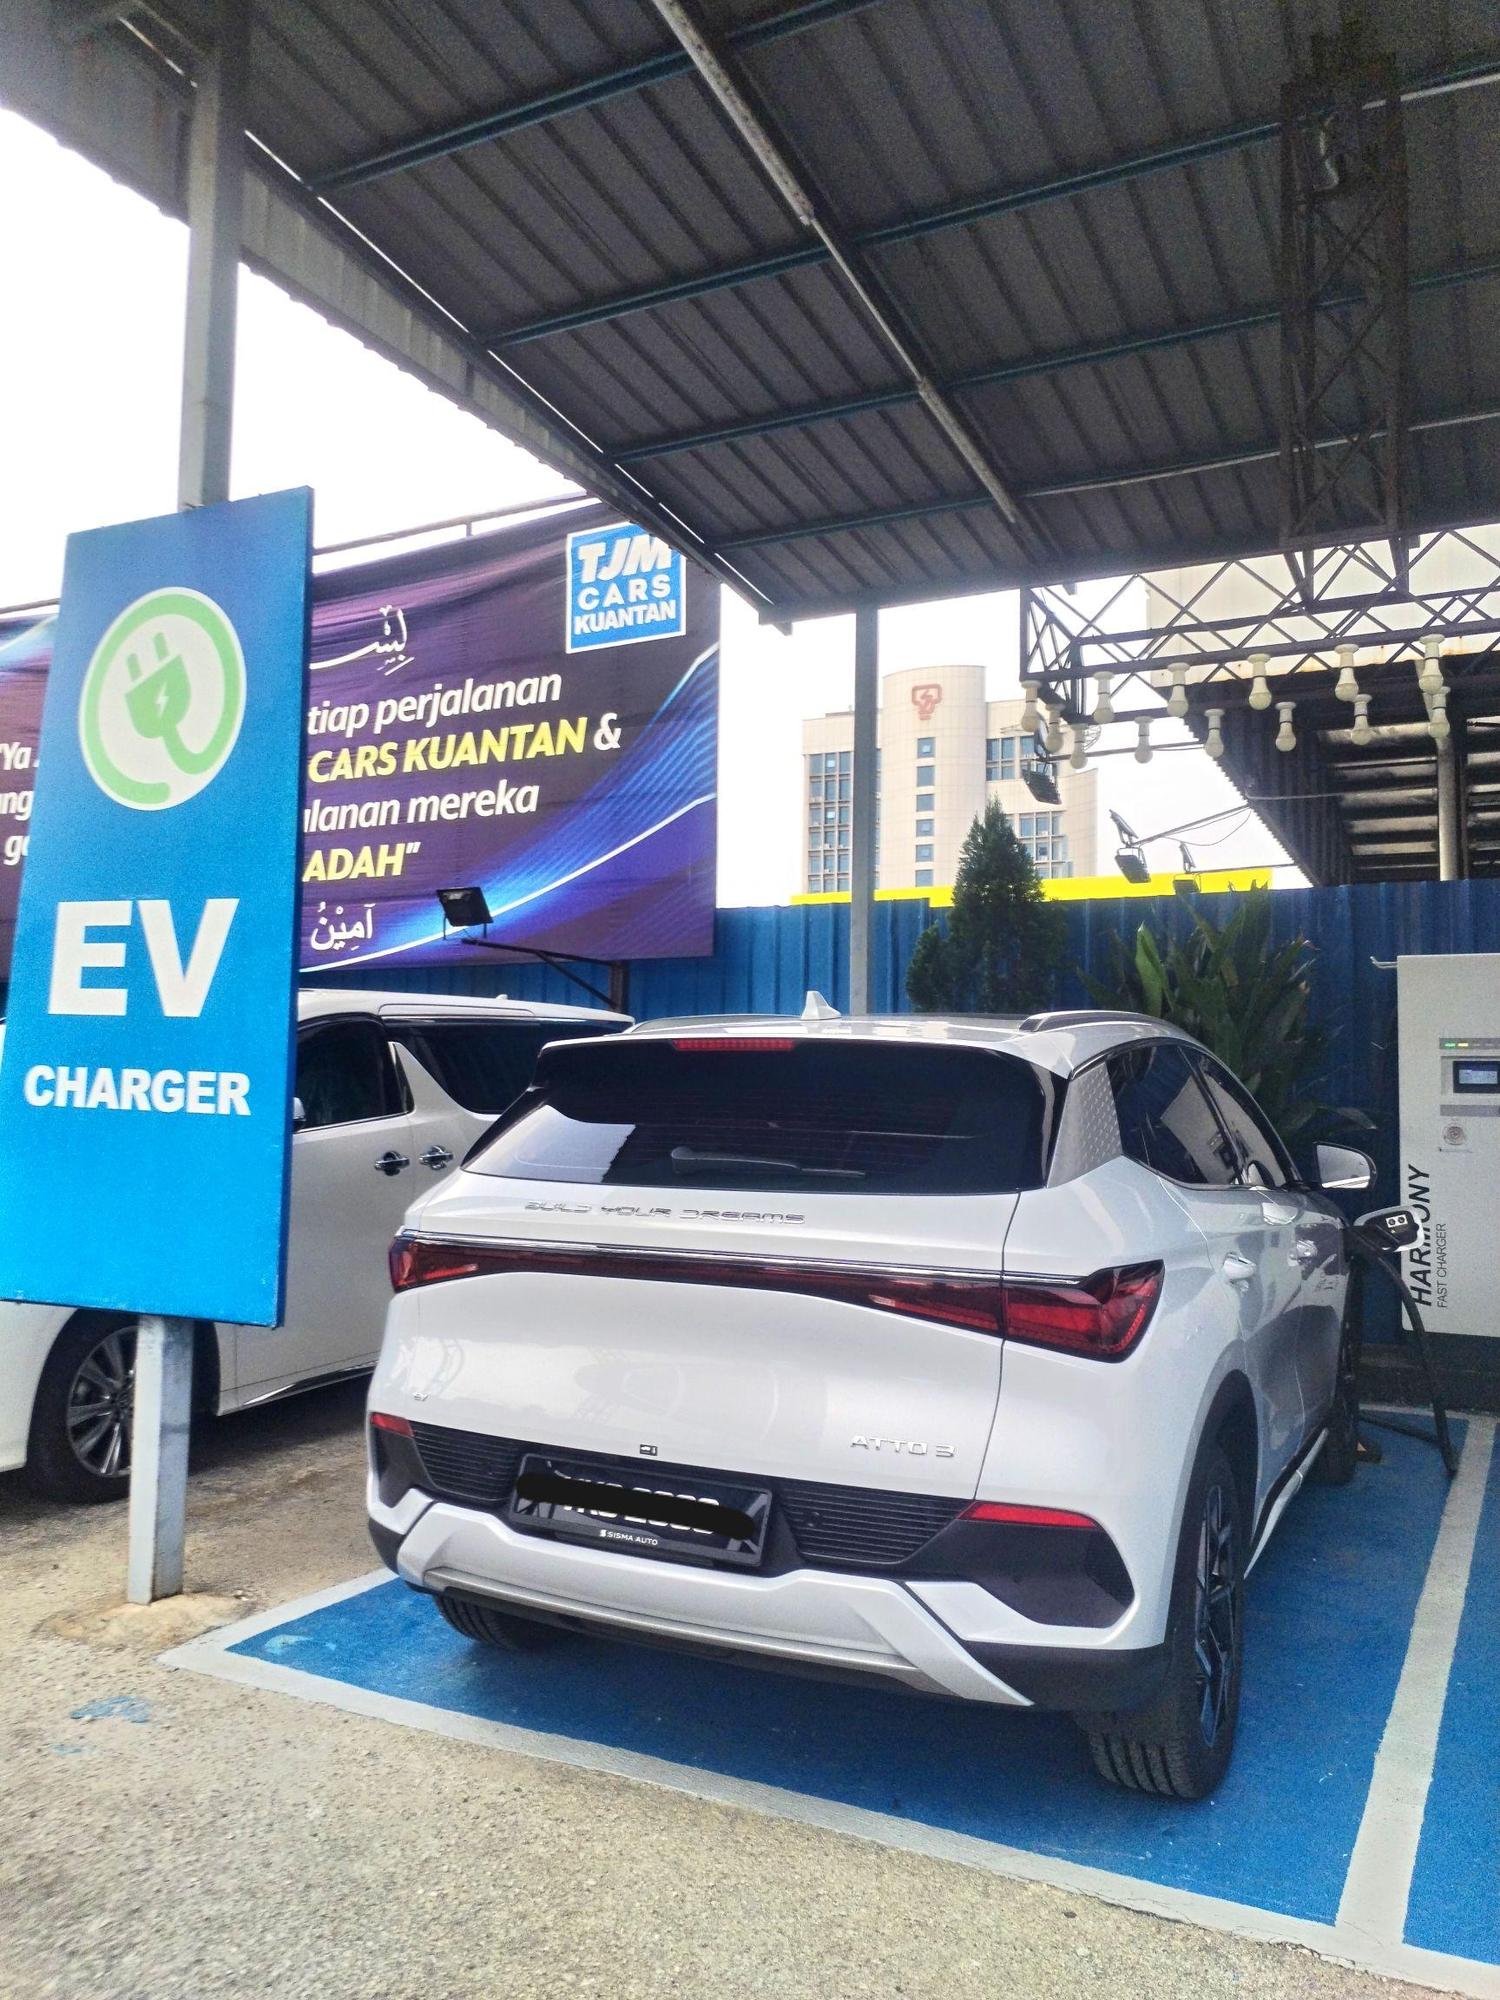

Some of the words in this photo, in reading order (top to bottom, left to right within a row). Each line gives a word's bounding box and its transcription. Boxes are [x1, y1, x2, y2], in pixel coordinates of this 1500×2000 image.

[578, 534, 672, 583] TJM
[577, 574, 671, 610] CARS
[574, 599, 676, 635] KUANTAN
[373, 673, 562, 734] perjalanan
[308, 742, 398, 782] CARS
[402, 717, 588, 772] KUANTAN
[594, 713, 622, 750] &
[407, 779, 540, 823] mereka
[47, 898, 240, 1018] EV
[24, 1065, 251, 1117] CHARGER
[525, 1200, 592, 1213] BUILD
[601, 1205, 672, 1218] YOUR
[679, 1208, 805, 1225] DREAMS
[1435, 1223, 1447, 1278] CHARGER
[1436, 1281, 1448, 1308] FAST
[850, 1435, 928, 1456] ATTO
[935, 1444, 956, 1458] 3
[607, 1531, 633, 1541] SISMA
[635, 1536, 658, 1546] AUTO
